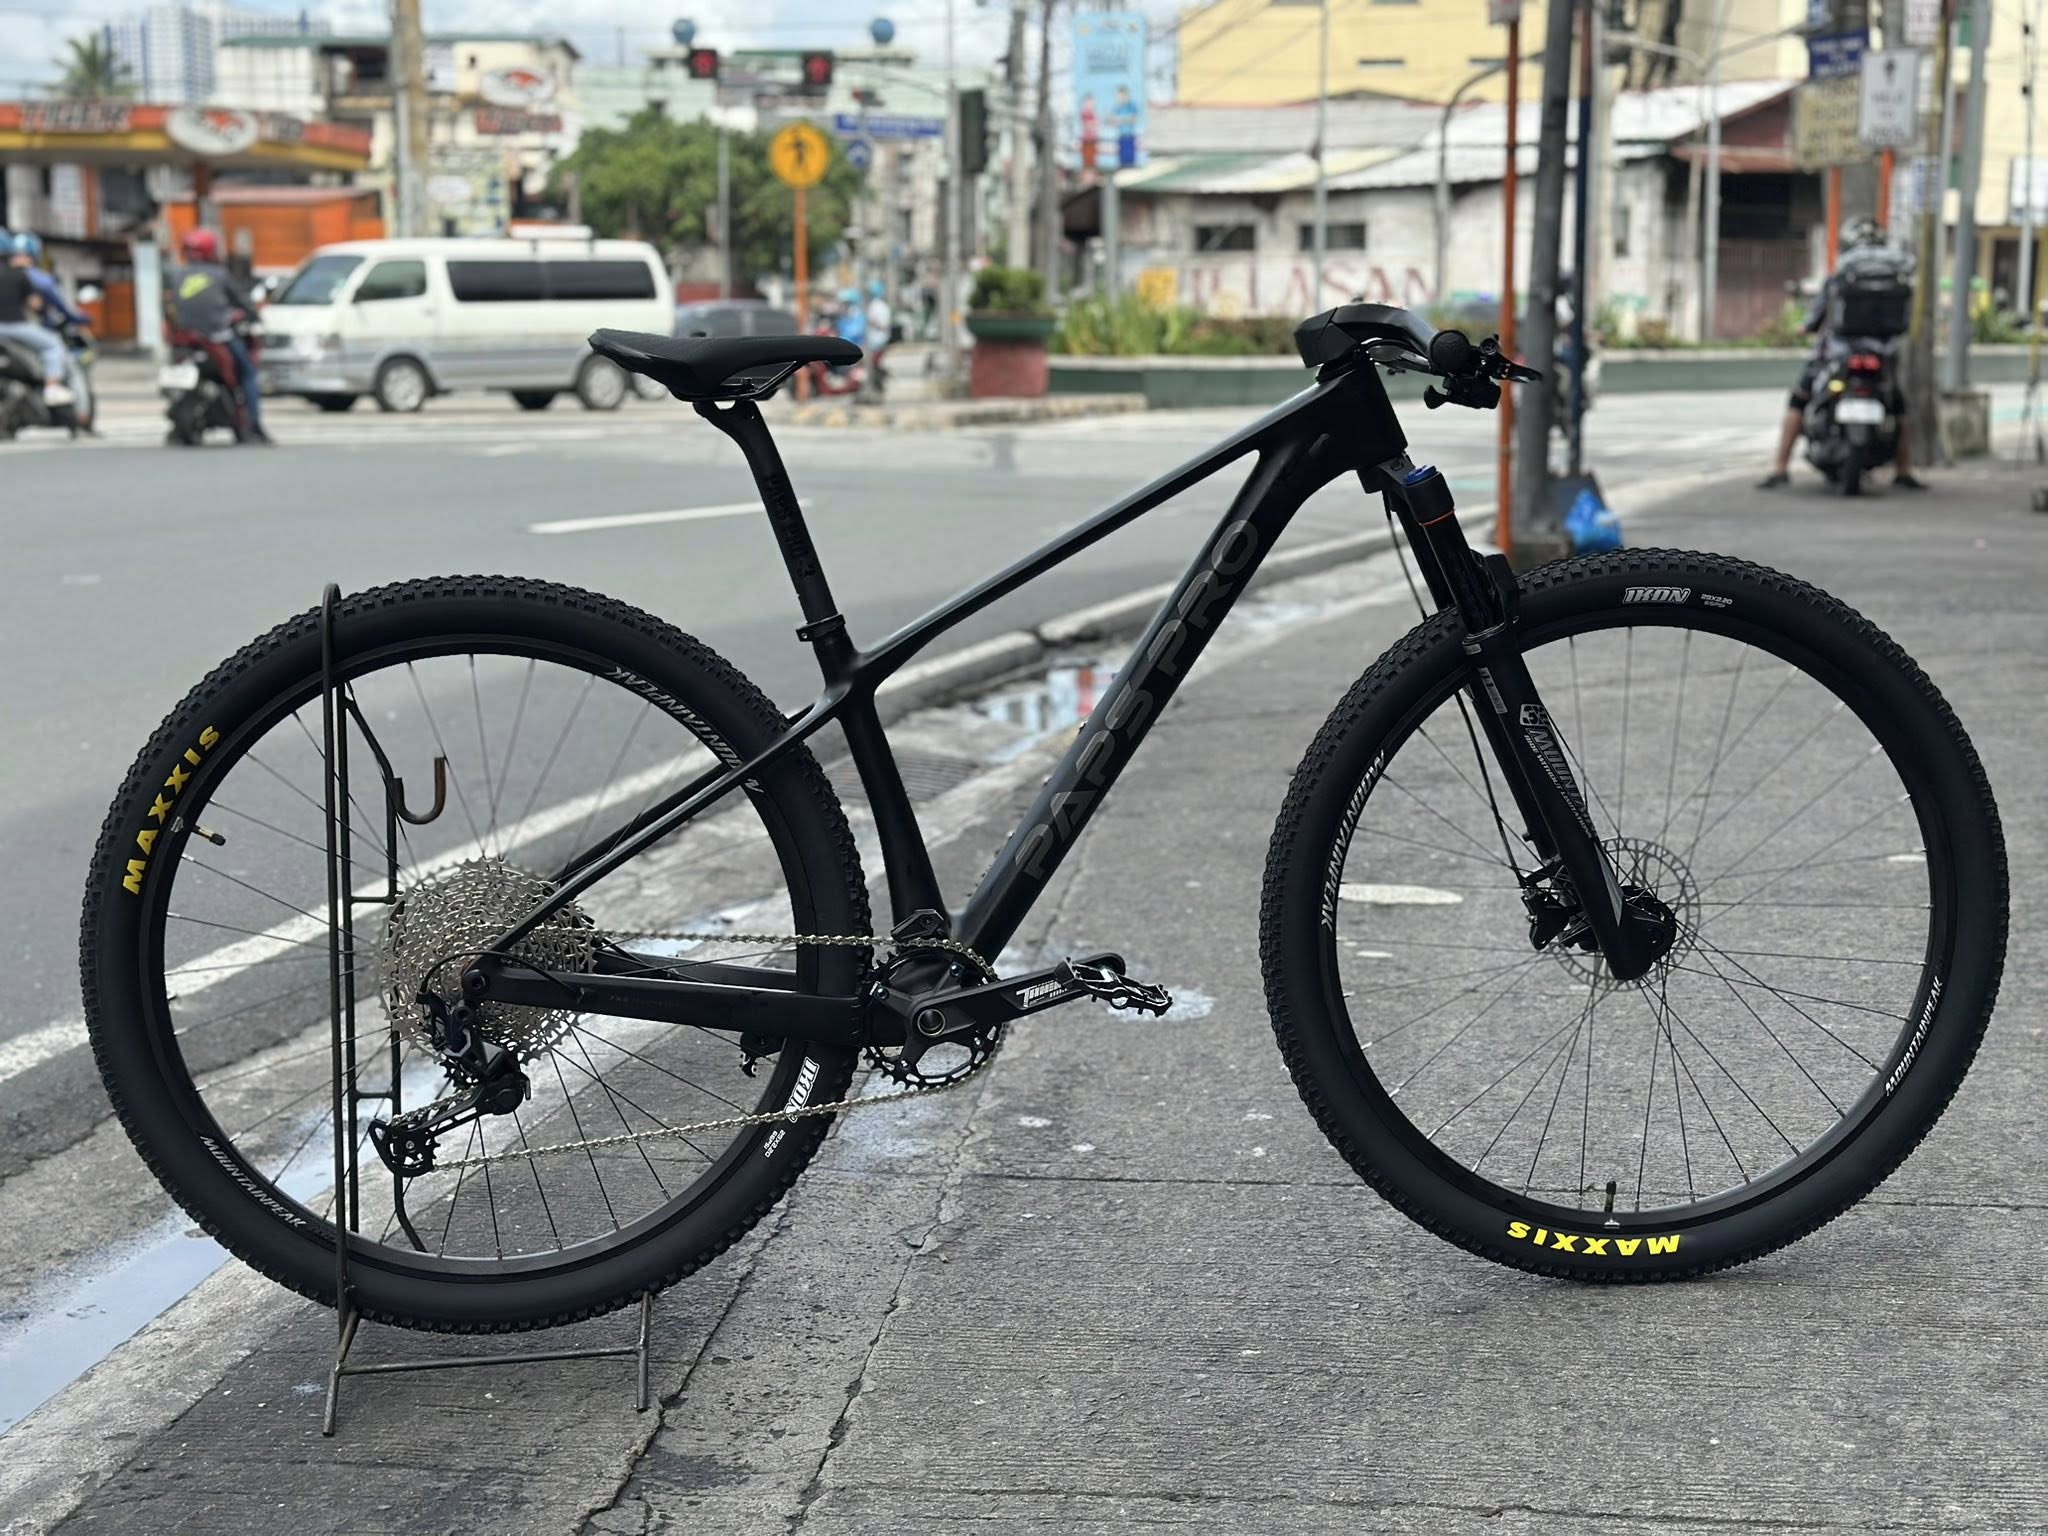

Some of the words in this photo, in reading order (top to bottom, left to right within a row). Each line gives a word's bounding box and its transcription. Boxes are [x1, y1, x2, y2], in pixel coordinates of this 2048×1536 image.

[1622, 586, 1691, 605] IKON
[1015, 680, 1153, 881] PAPS
[1148, 519, 1258, 677] PRO
[122, 725, 220, 896] MAXXIS
[1536, 753, 1562, 790] WITHOUT
[1321, 748, 1386, 932] MOUNTAINPEAK
[1885, 975, 1943, 1097] MOUNTAINPEAK
[783, 1056, 820, 1123] IKON
[200, 1135, 308, 1228] MOUNTAINPEAK
[1506, 1221, 1681, 1256] MAXXIS
